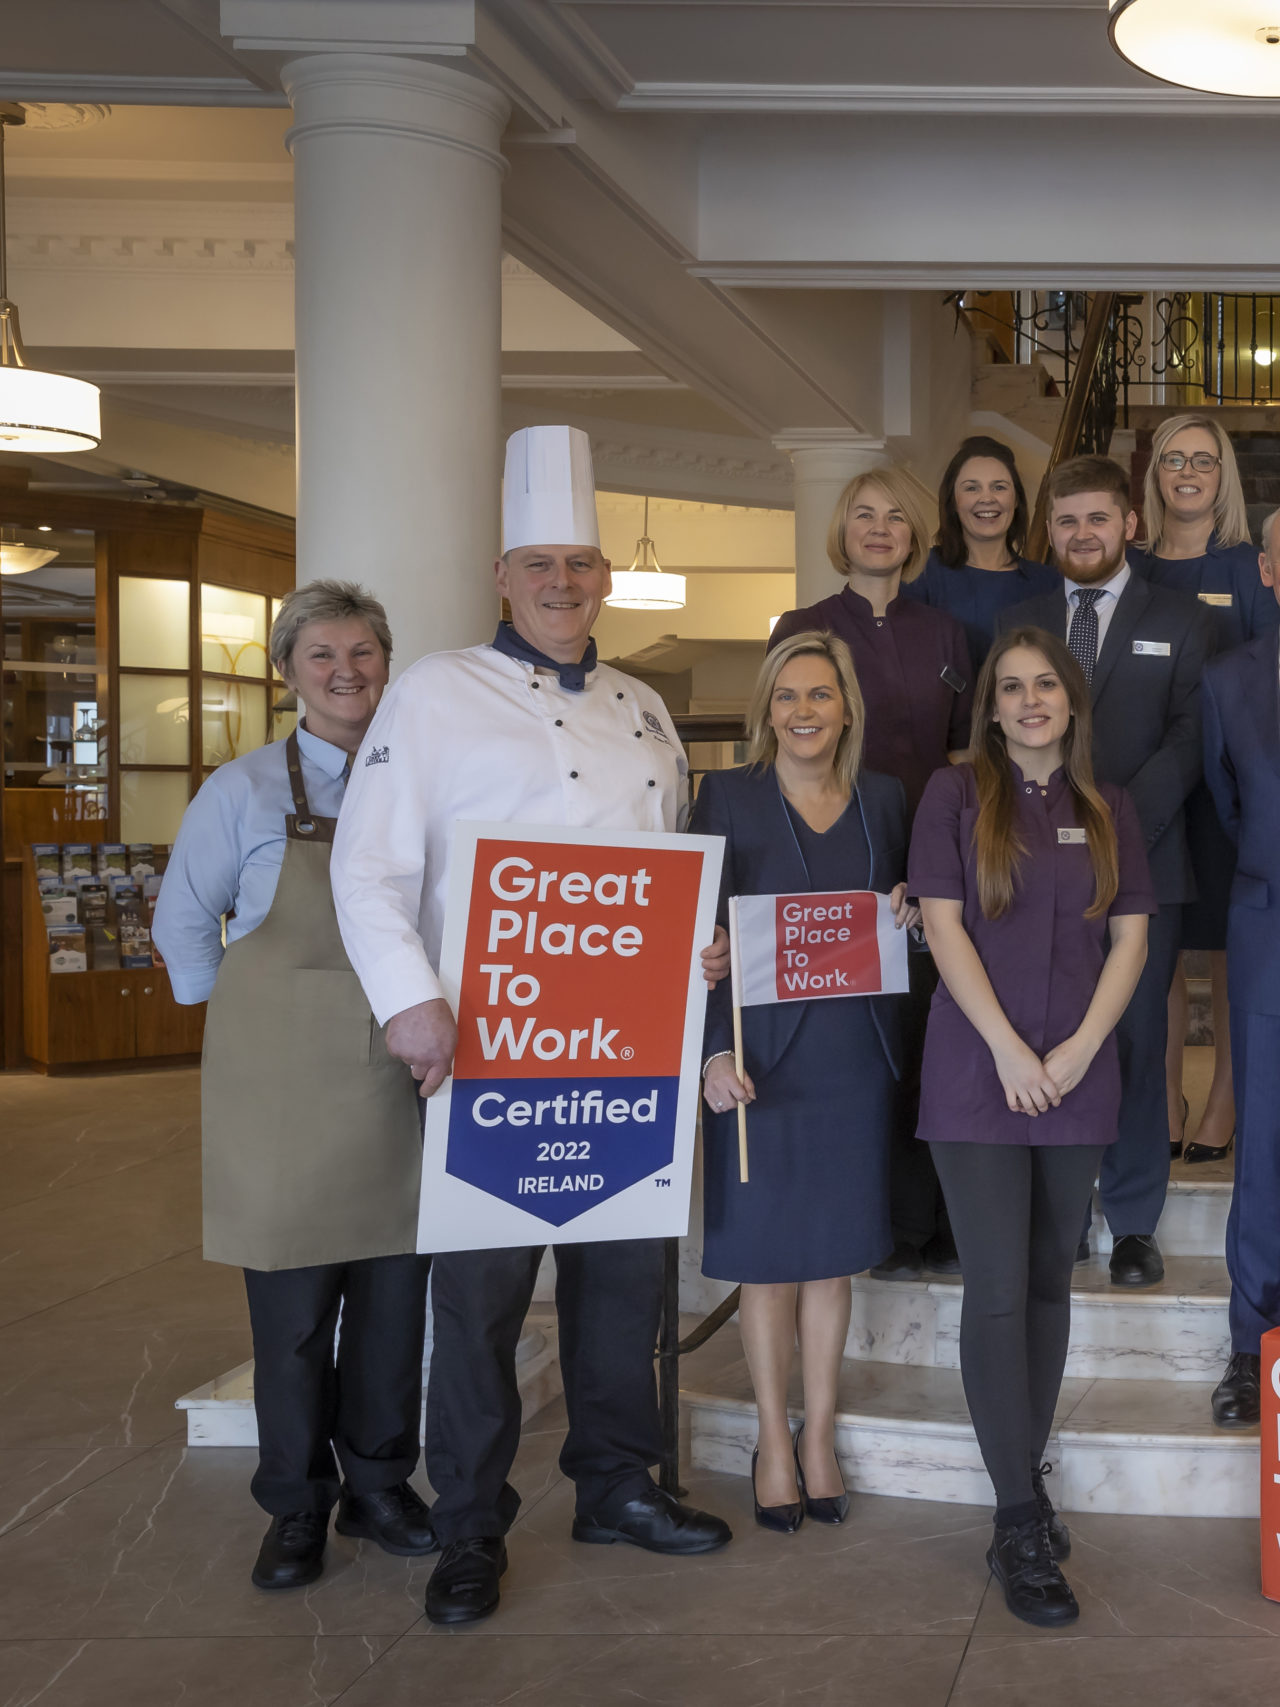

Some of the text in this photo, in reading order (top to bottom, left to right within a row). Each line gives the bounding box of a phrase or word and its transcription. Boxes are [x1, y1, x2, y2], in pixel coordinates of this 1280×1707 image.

[489, 856, 653, 906] Great
[782, 902, 853, 923] Great
[487, 909, 643, 957] Place
[785, 926, 851, 946] Place
[783, 949, 809, 969] To
[480, 963, 541, 1007] To
[472, 1089, 659, 1128] Certified
[536, 1141, 591, 1162] 2022
[517, 1174, 605, 1195] IRELAND
